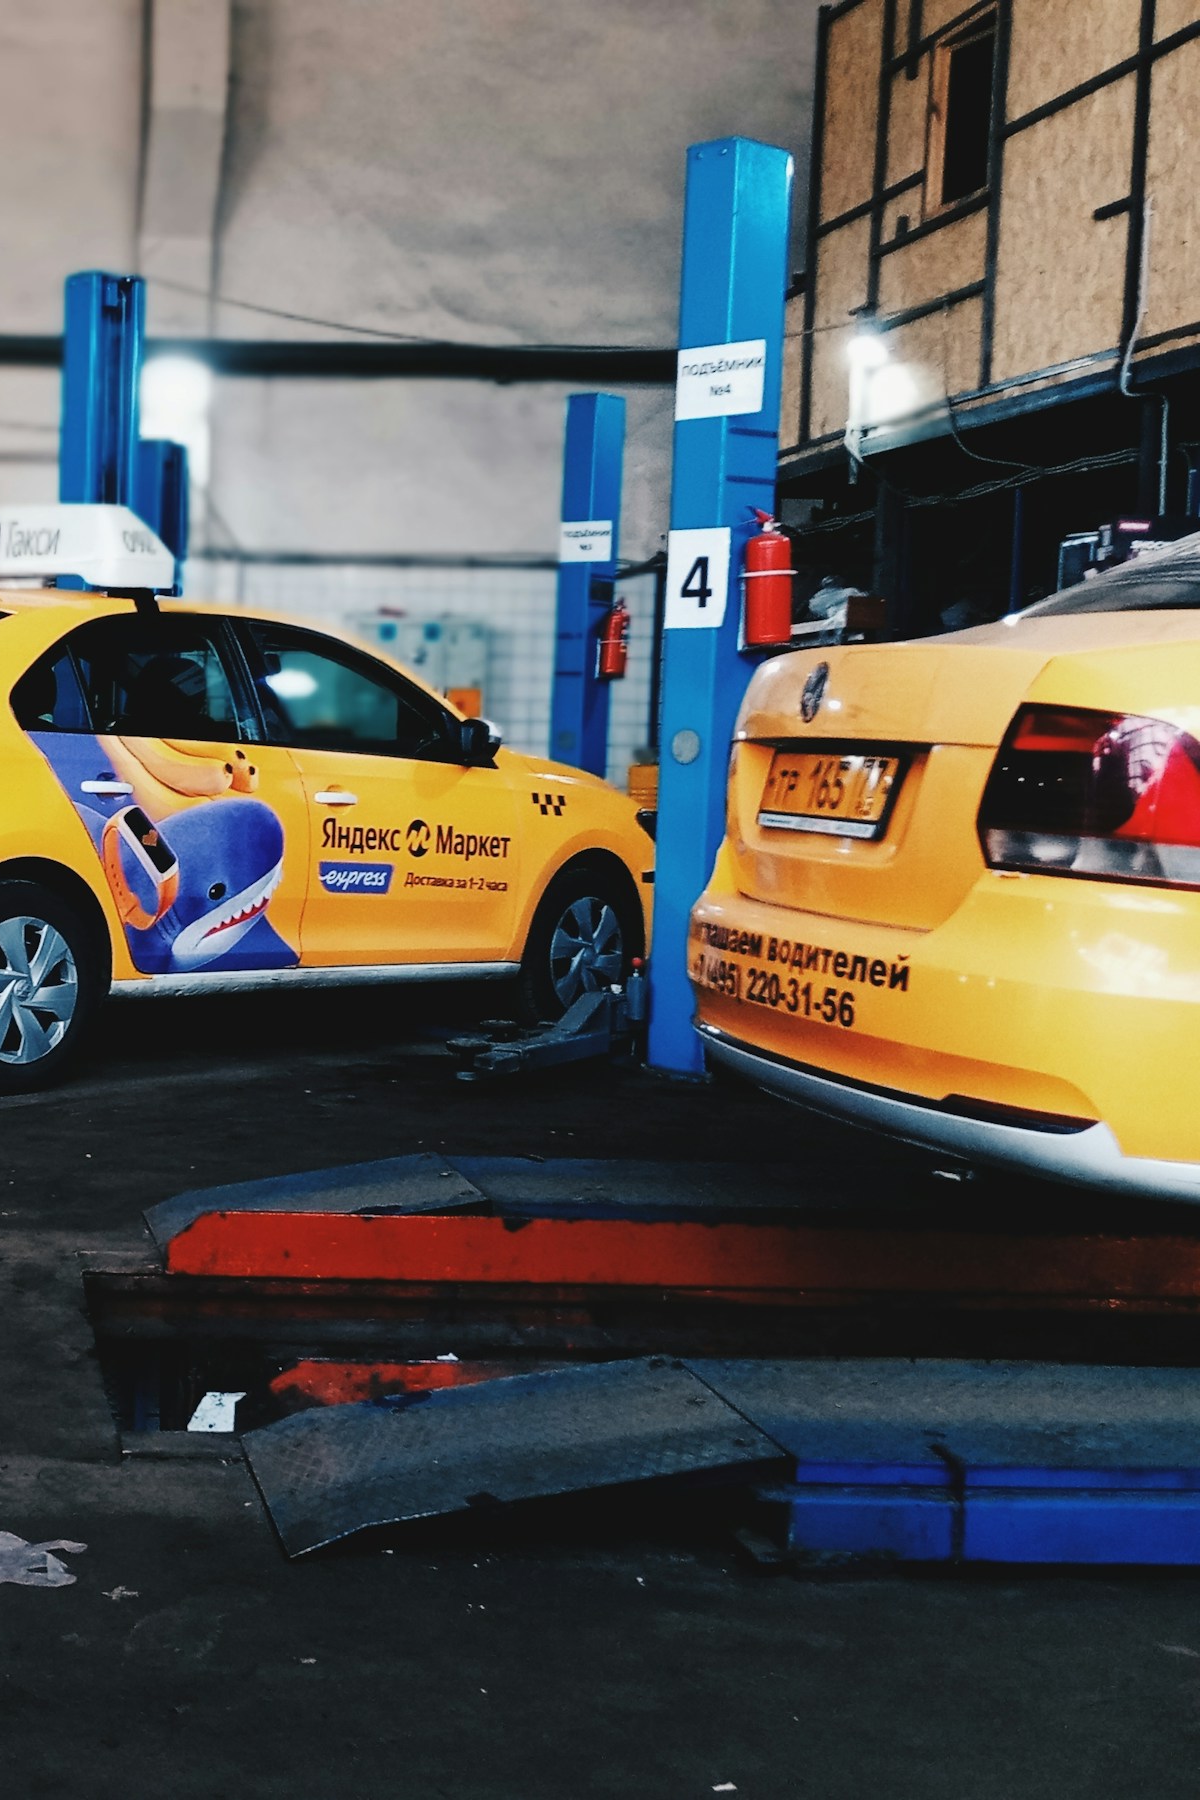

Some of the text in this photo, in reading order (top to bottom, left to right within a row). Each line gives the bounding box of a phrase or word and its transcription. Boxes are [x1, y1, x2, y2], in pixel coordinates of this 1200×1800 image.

[5, 521, 61, 558] Такси
[681, 556, 712, 608] 4
[321, 817, 400, 854] Яндекс
[435, 825, 511, 861] Маркет
[319, 867, 388, 891] express
[404, 872, 453, 889] Доставка
[455, 877, 466, 889] за
[486, 879, 508, 892] часа
[768, 937, 910, 992] водителей
[747, 967, 855, 1028] 220-31-56
